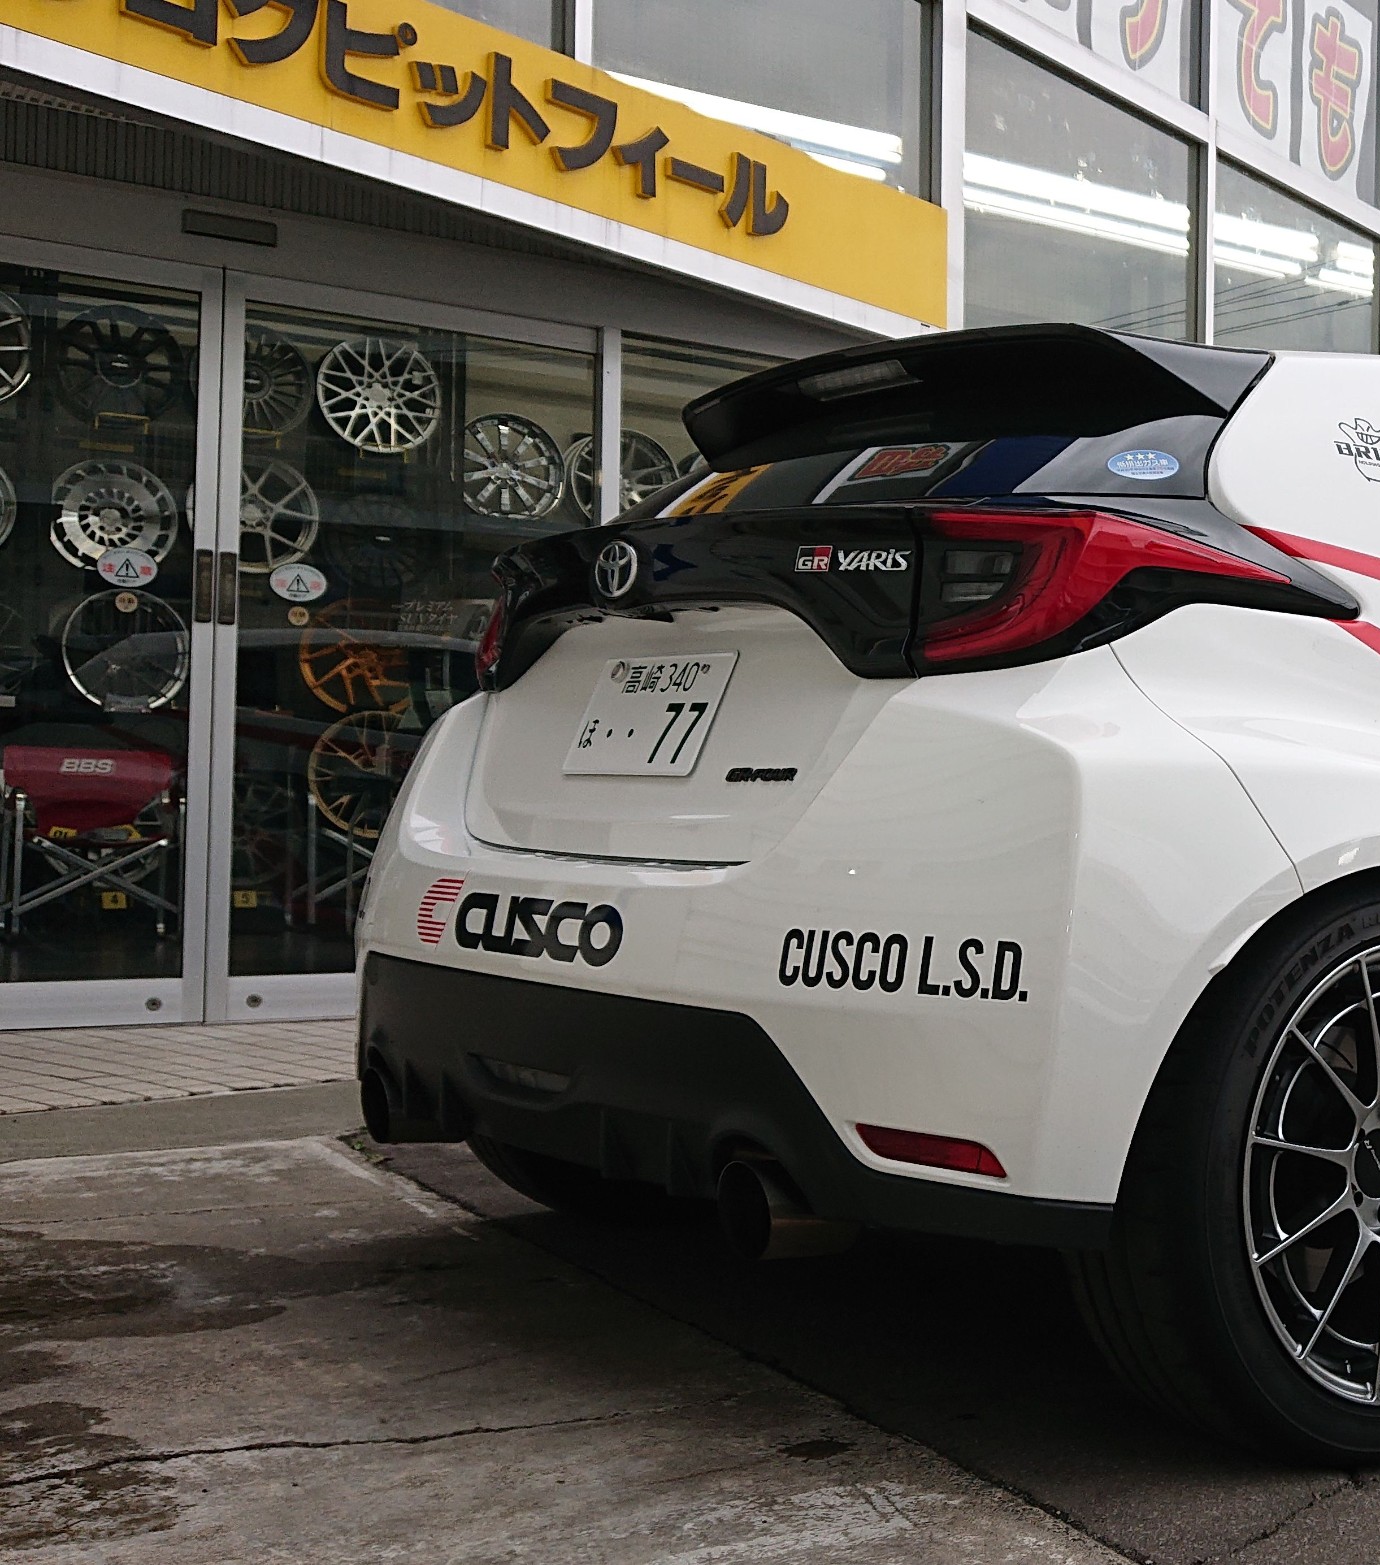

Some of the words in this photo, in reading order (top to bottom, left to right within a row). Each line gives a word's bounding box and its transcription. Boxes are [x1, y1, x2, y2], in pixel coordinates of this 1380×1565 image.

[797, 556, 829, 570] GR
[837, 548, 912, 571] YARIS
[622, 665, 664, 694] 高崎
[660, 662, 700, 693] 340
[578, 719, 600, 749] ほ
[60, 758, 116, 774] BBS
[454, 892, 624, 967] CUSCO
[778, 927, 909, 992] CUSCO
[917, 935, 1030, 1003] L.S.D.
[1242, 917, 1357, 1060] POTENZA
